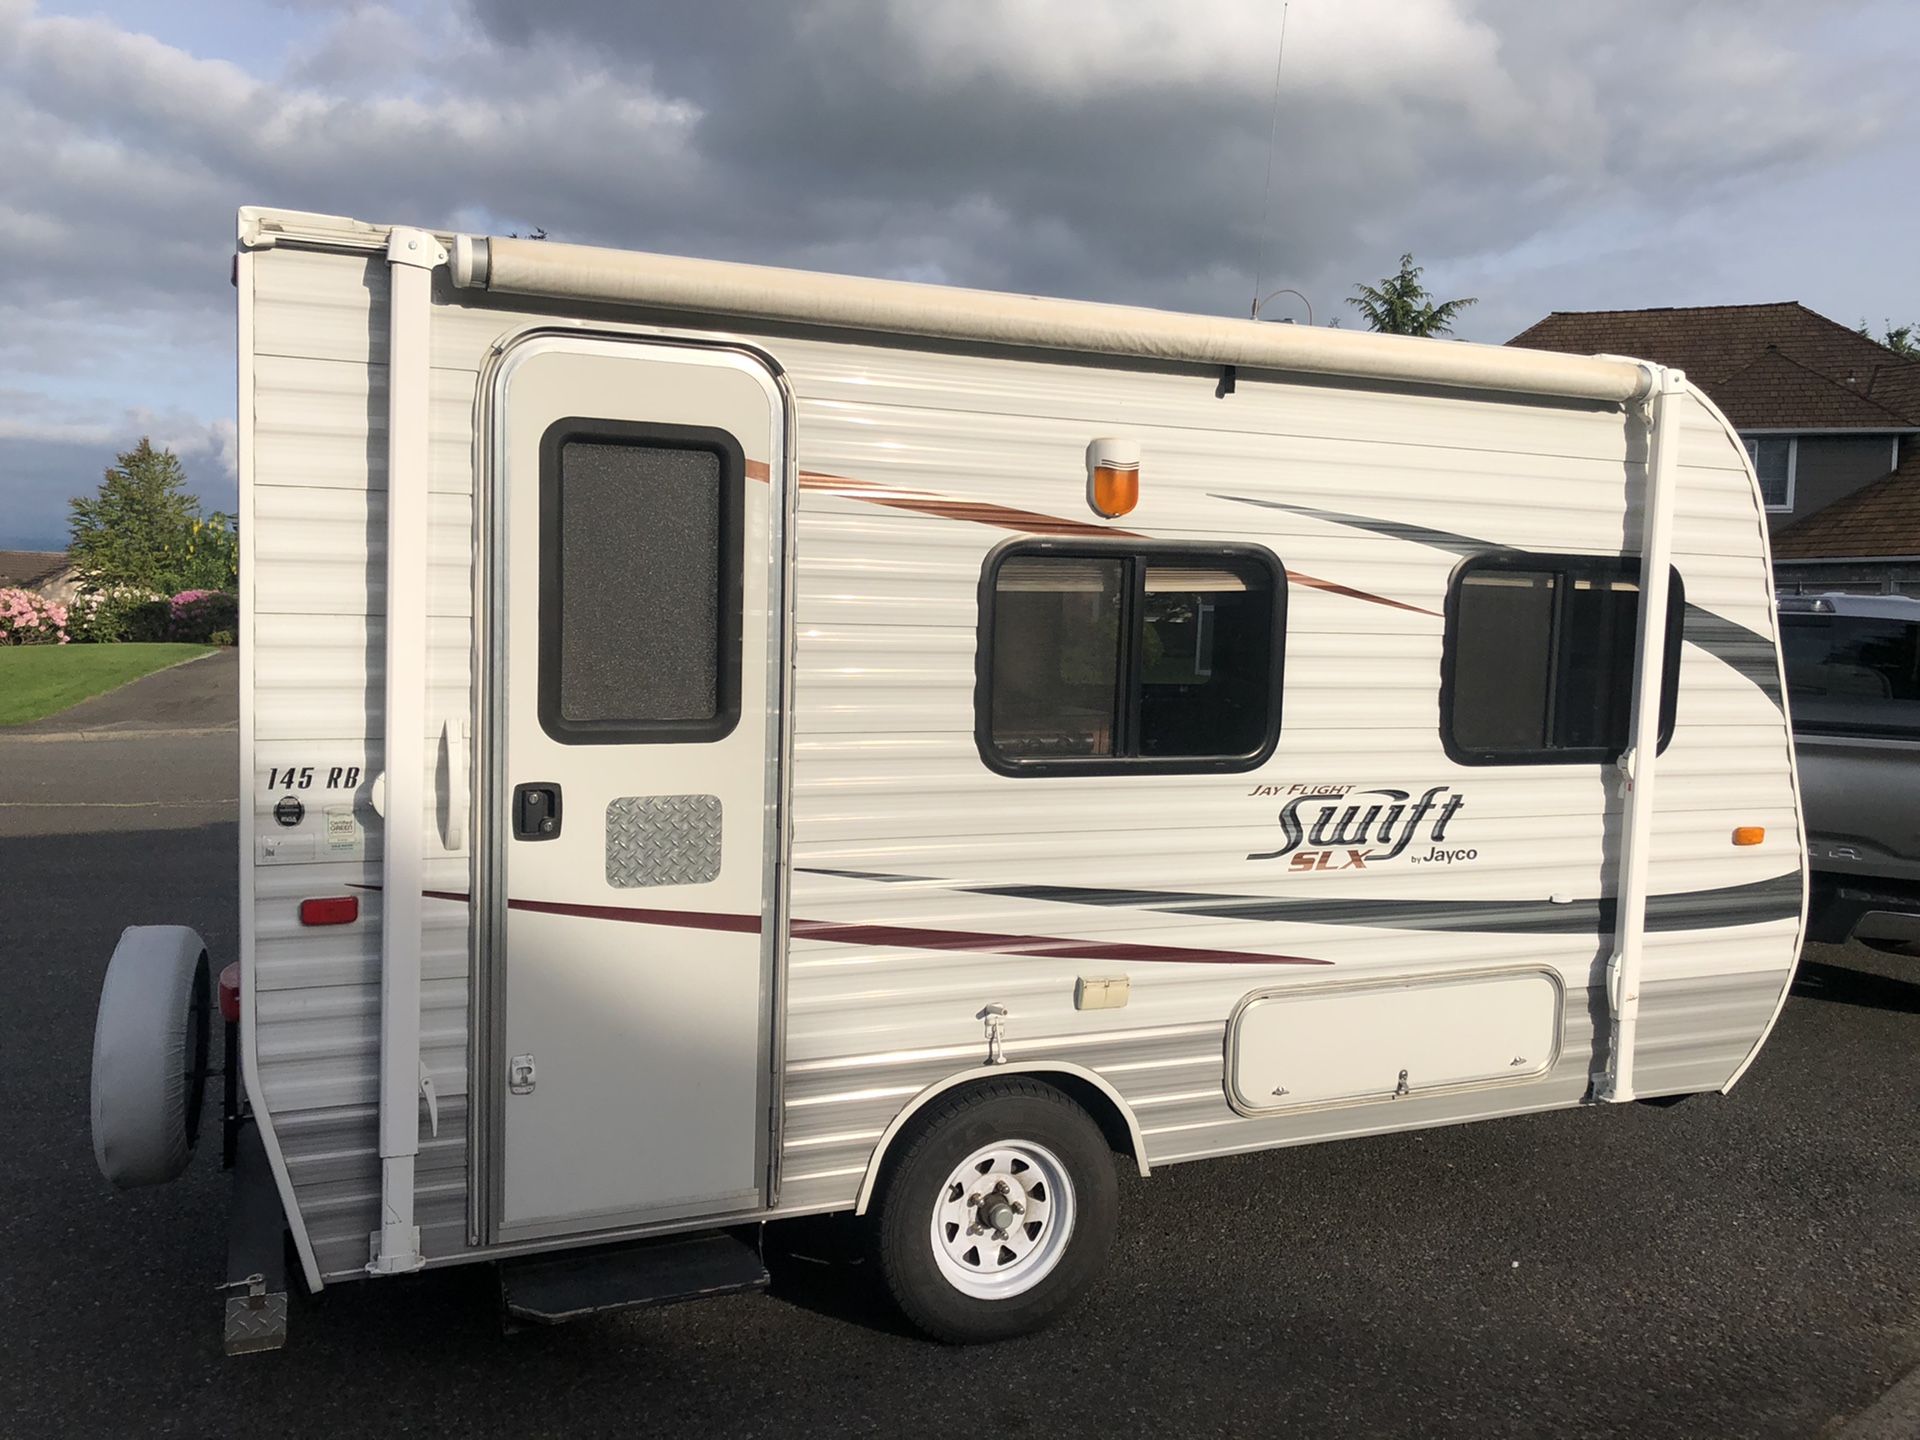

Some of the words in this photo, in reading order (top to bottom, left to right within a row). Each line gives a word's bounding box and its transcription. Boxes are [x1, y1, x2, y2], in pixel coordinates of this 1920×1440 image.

[267, 767, 315, 790] 145
[326, 766, 361, 789] RB
[1246, 786, 1465, 861] Swift
[1288, 849, 1375, 872] SLX
[1411, 855, 1422, 864] by
[1423, 846, 1478, 864] Jayco
